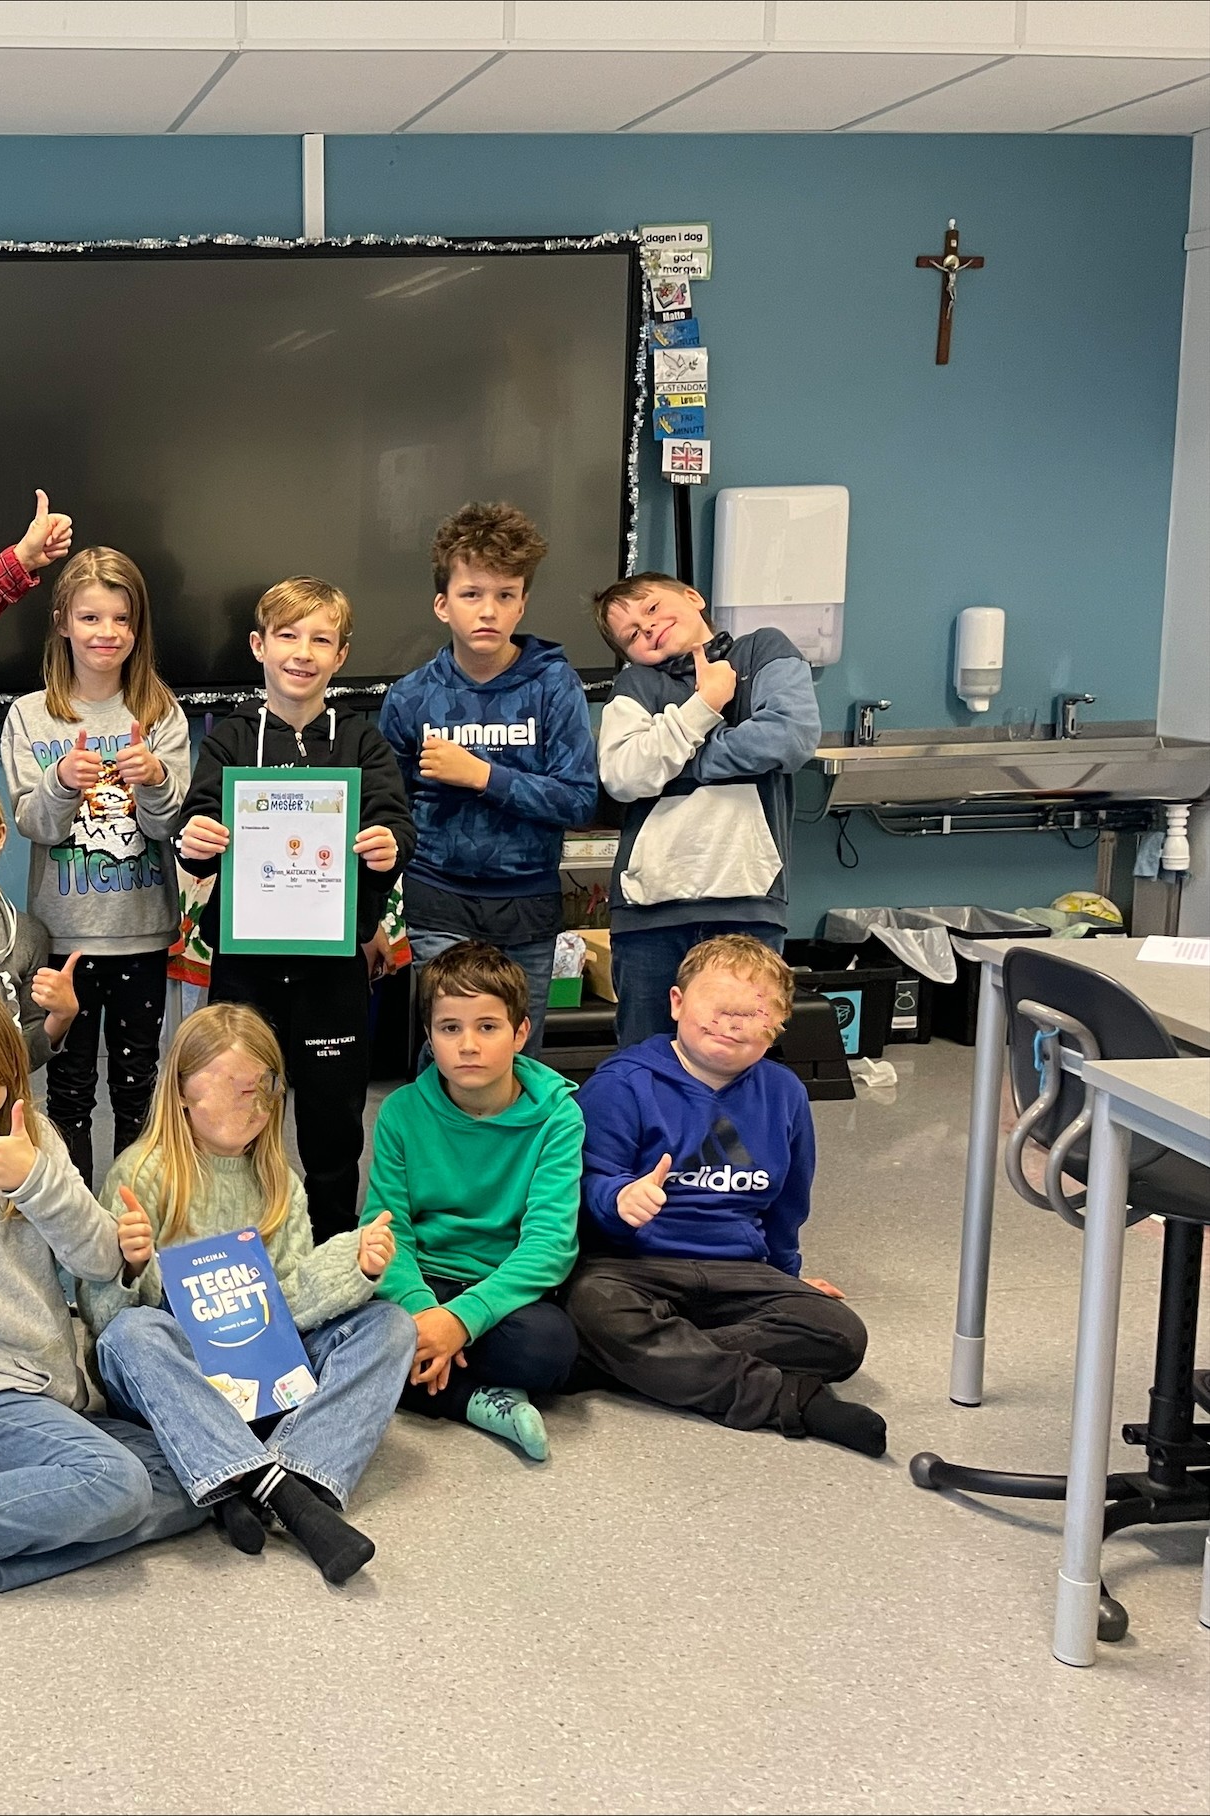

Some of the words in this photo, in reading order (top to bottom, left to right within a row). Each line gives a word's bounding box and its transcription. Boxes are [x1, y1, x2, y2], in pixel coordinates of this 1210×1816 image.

[646, 234, 677, 244] dagen
[683, 232, 703, 243] dag
[673, 253, 693, 264] god
[662, 266, 702, 275] morgen
[662, 311, 686, 322] Matte
[656, 383, 707, 391] KISTENDOM
[670, 473, 702, 484] Engelsk
[422, 717, 536, 746] hummel
[192, 1251, 227, 1266] ORIGINAL
[181, 1263, 253, 1299] TEGN
[191, 1282, 269, 1322] GJETT
